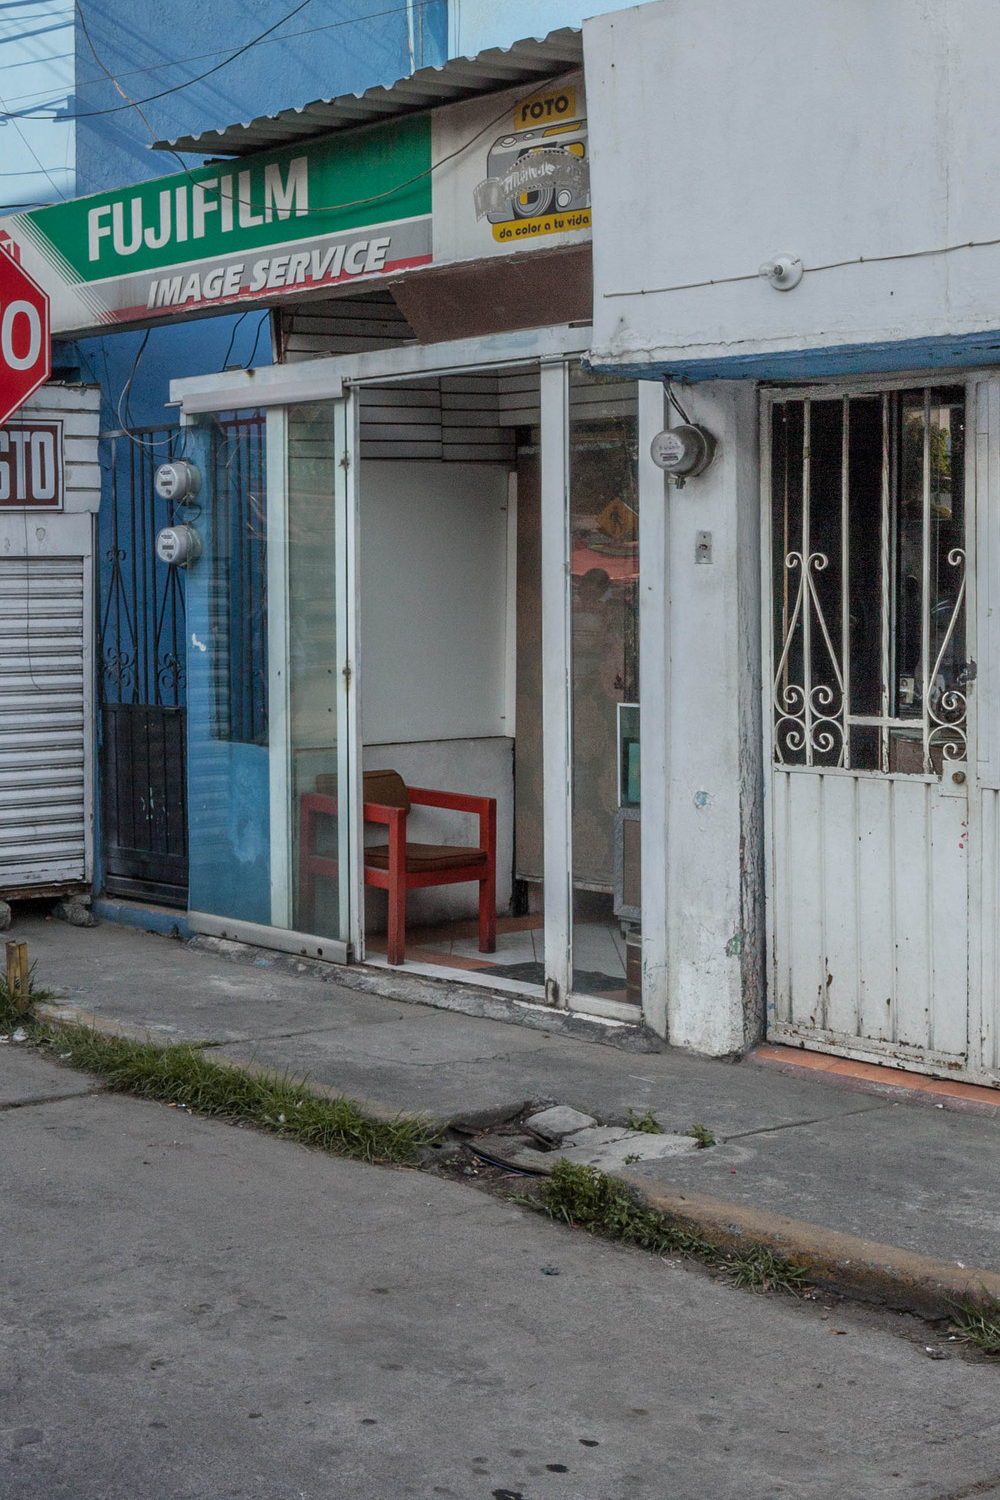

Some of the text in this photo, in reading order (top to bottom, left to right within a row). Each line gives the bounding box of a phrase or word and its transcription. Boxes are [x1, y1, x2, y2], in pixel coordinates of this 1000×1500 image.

[521, 95, 569, 122] FOTO
[88, 156, 309, 262] FUJIFILM
[499, 214, 589, 239] da color a tu vida
[146, 236, 391, 310] IMAGE SERVICE
